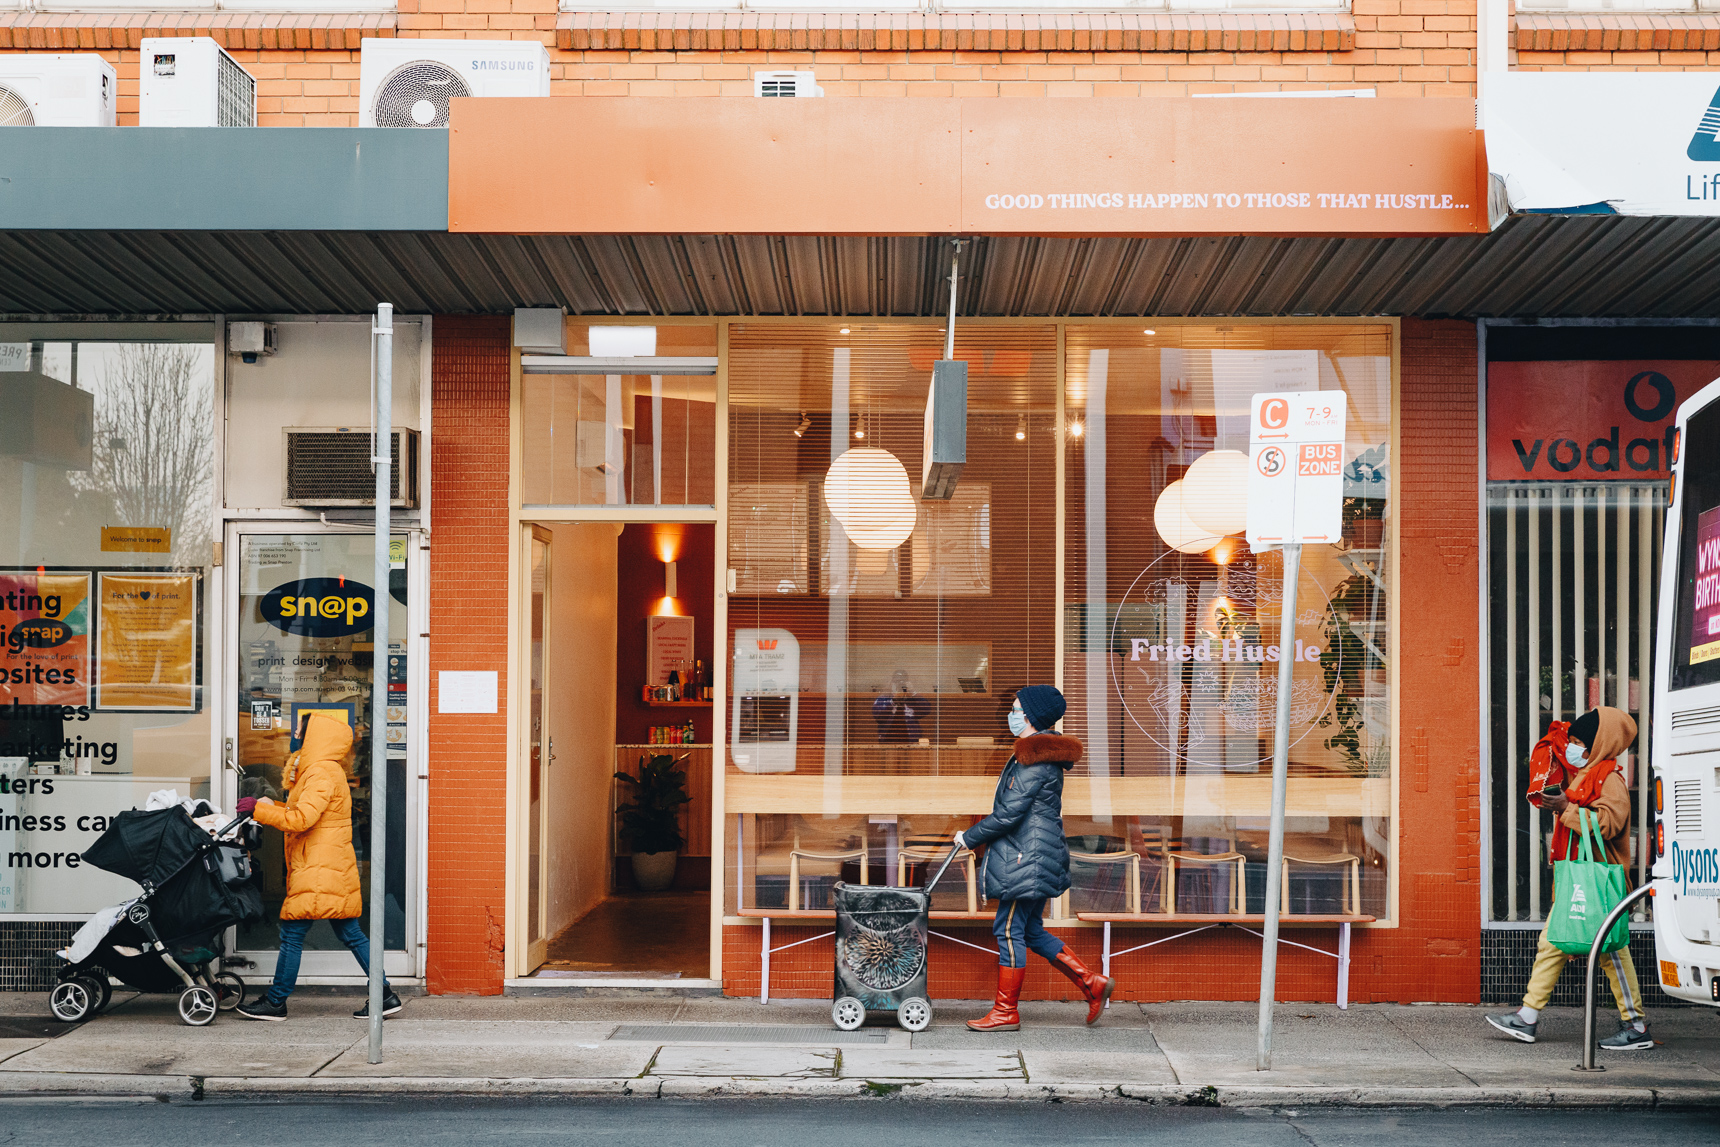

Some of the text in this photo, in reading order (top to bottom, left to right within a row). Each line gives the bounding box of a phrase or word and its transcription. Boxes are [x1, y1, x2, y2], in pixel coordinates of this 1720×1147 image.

[472, 60, 534, 71] SAMSUNG
[1687, 173, 1720, 200] Lif
[985, 193, 1470, 209] GOOD THINGS HAPPEN TO THOSE THAT HUSTLE...
[1265, 400, 1283, 427] C
[1306, 407, 1332, 419] 7-9
[1305, 445, 1336, 459] BUS
[1512, 425, 1675, 473] vodaf
[1300, 460, 1340, 475] ZONE
[110, 535, 137, 543] Welcome
[161, 592, 181, 601] print.
[1695, 574, 1720, 611] BIRTH
[280, 596, 368, 625] sn@p
[21, 627, 63, 643] snap
[60, 653, 78, 661] print
[1130, 637, 1321, 662] Fried Husle
[258, 655, 285, 668] print
[292, 655, 331, 668] design
[1, 735, 117, 765] arketing
[0, 774, 54, 794] ters
[8, 852, 81, 868] more
[1672, 841, 1719, 896] Dysons
[0, 900, 6, 908] N
